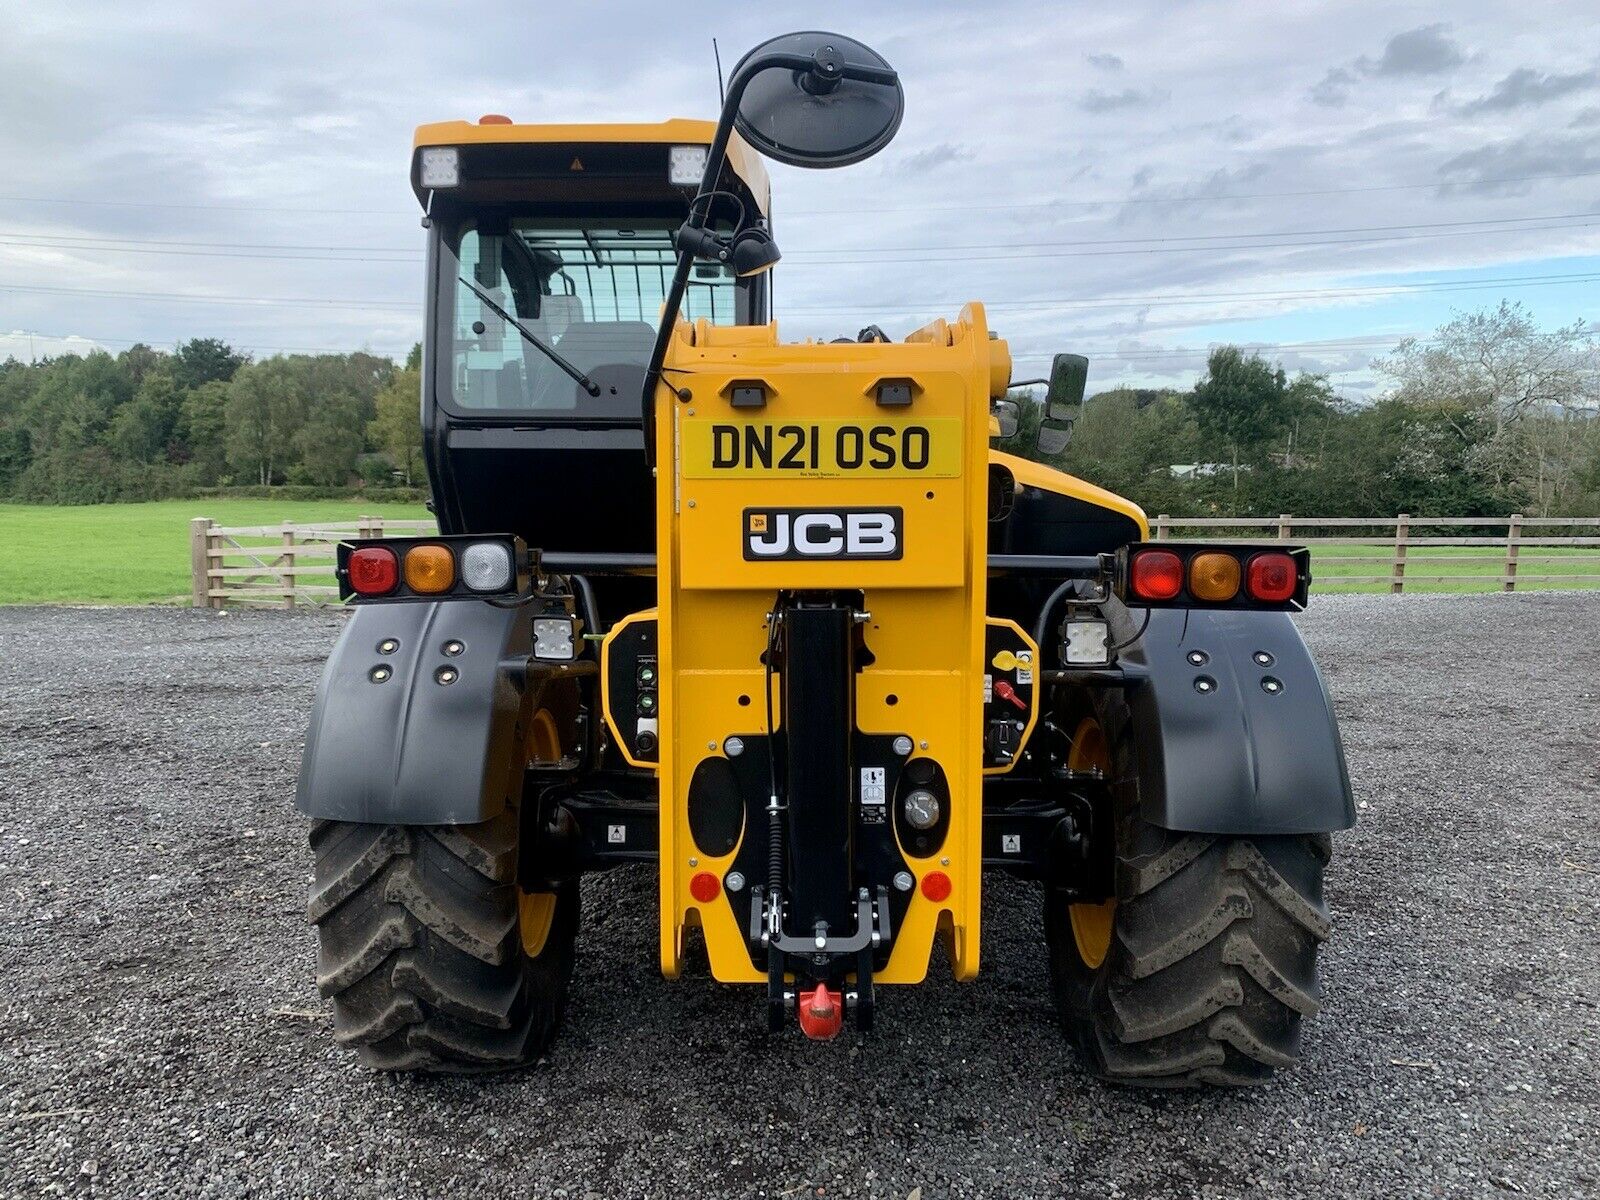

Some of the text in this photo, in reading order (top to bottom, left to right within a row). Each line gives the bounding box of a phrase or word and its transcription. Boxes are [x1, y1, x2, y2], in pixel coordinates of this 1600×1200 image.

[712, 425, 929, 470] DN21 OSO
[750, 513, 897, 555] JCB
